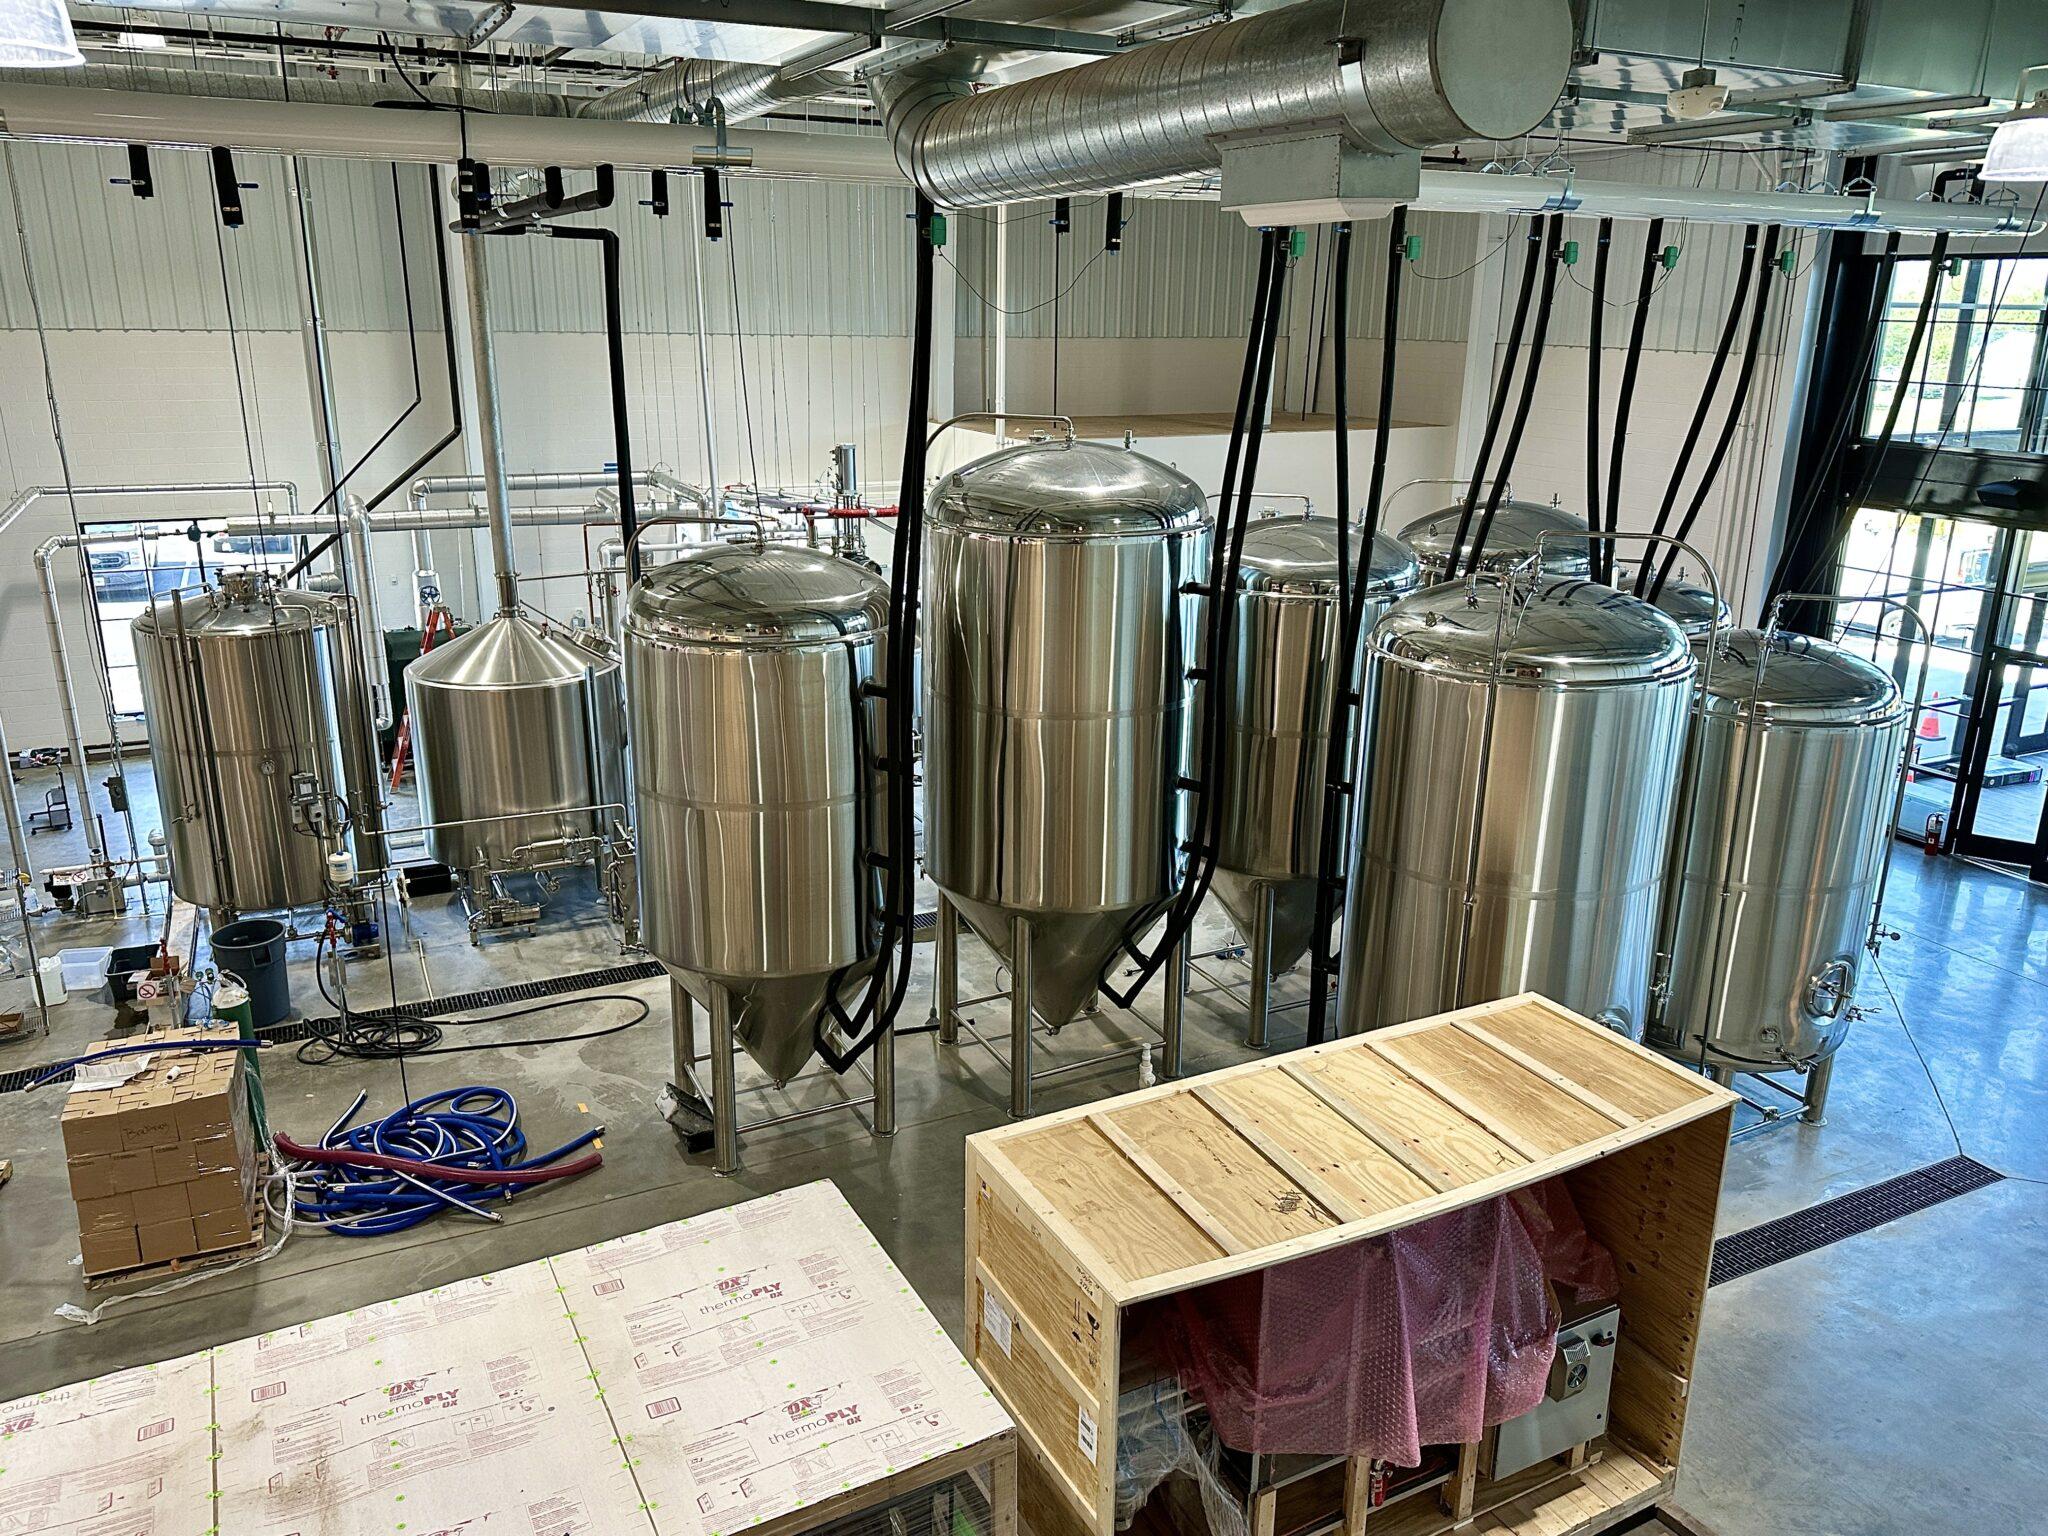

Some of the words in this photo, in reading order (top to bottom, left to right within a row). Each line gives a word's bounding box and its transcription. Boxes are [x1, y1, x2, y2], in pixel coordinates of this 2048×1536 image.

[700, 1282, 780, 1315] thermoPLY
[768, 1404, 858, 1445] thermoPLY
[846, 1415, 862, 1426] OX
